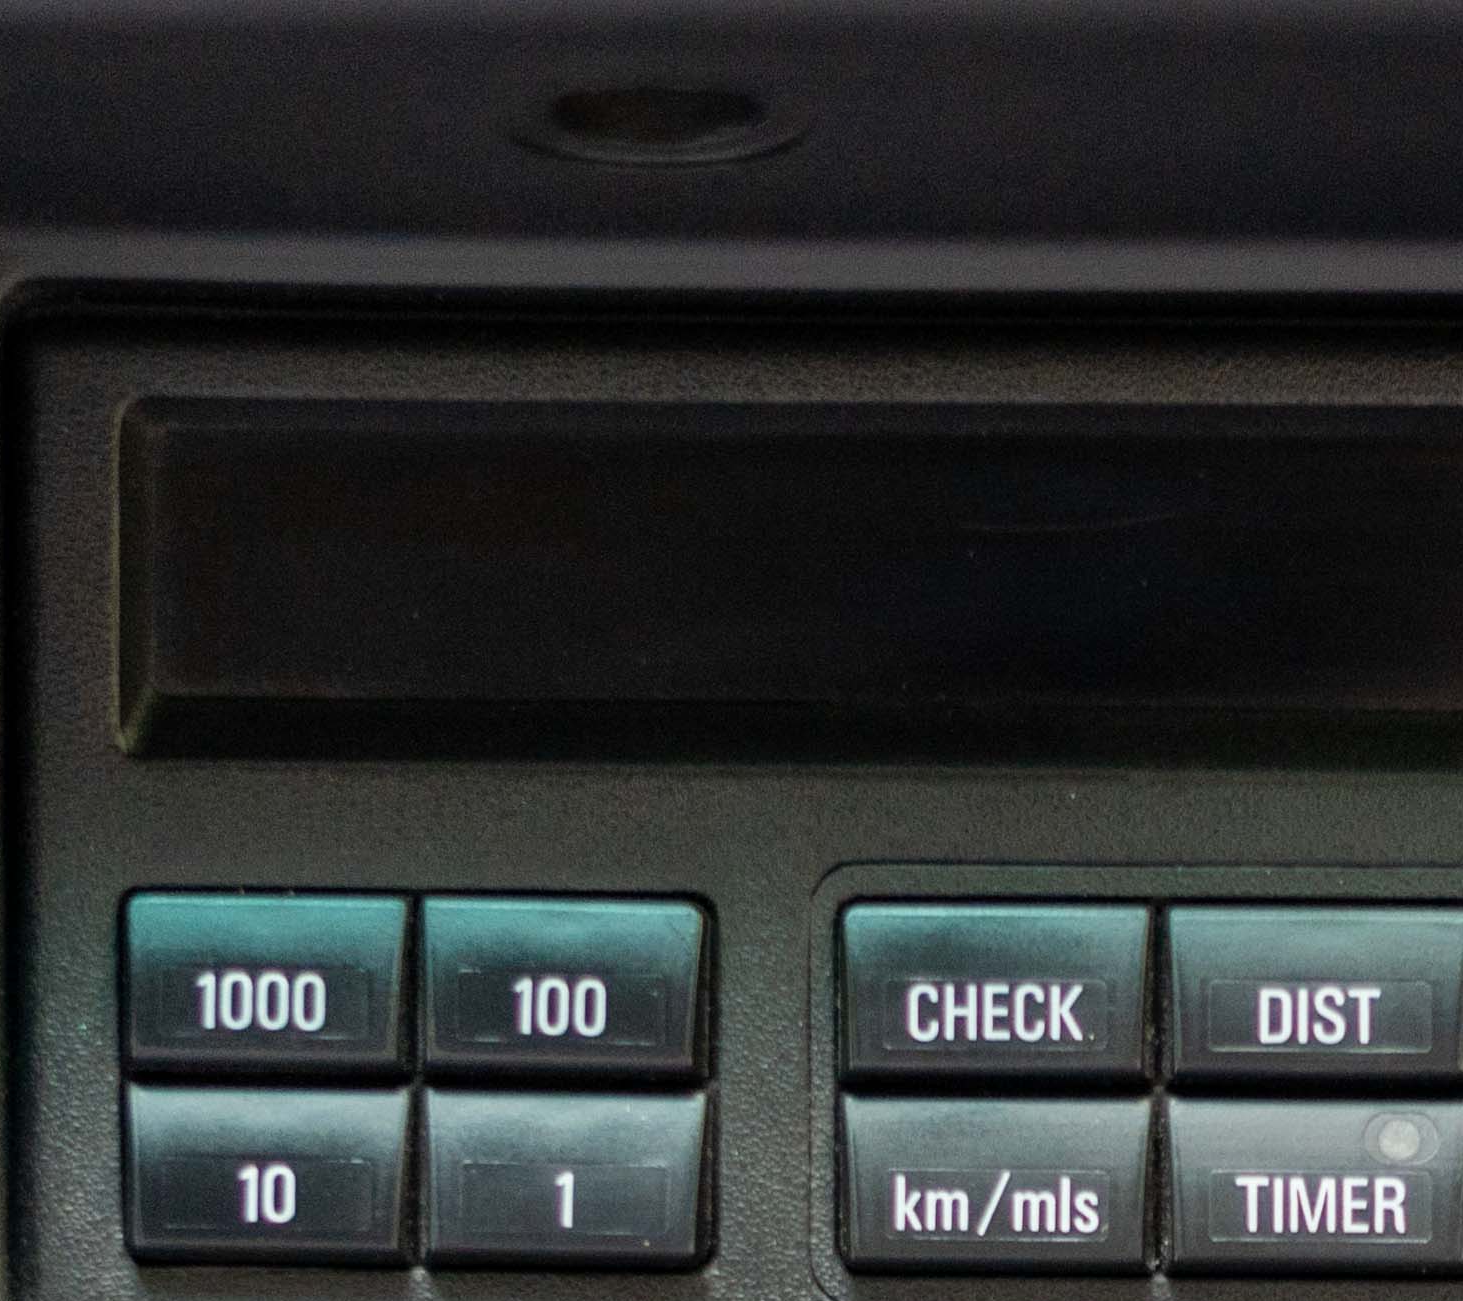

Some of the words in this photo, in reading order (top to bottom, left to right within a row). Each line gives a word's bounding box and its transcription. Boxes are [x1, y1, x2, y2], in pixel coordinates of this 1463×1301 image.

[196, 969, 327, 1032] 1000
[513, 976, 608, 1038] 100
[906, 982, 1085, 1043] CHECK
[1257, 984, 1382, 1046] DIST
[237, 1163, 297, 1224] 10
[554, 1170, 576, 1229] 1
[893, 1170, 1101, 1237] km/mls
[1234, 1175, 1407, 1235] TIMER
